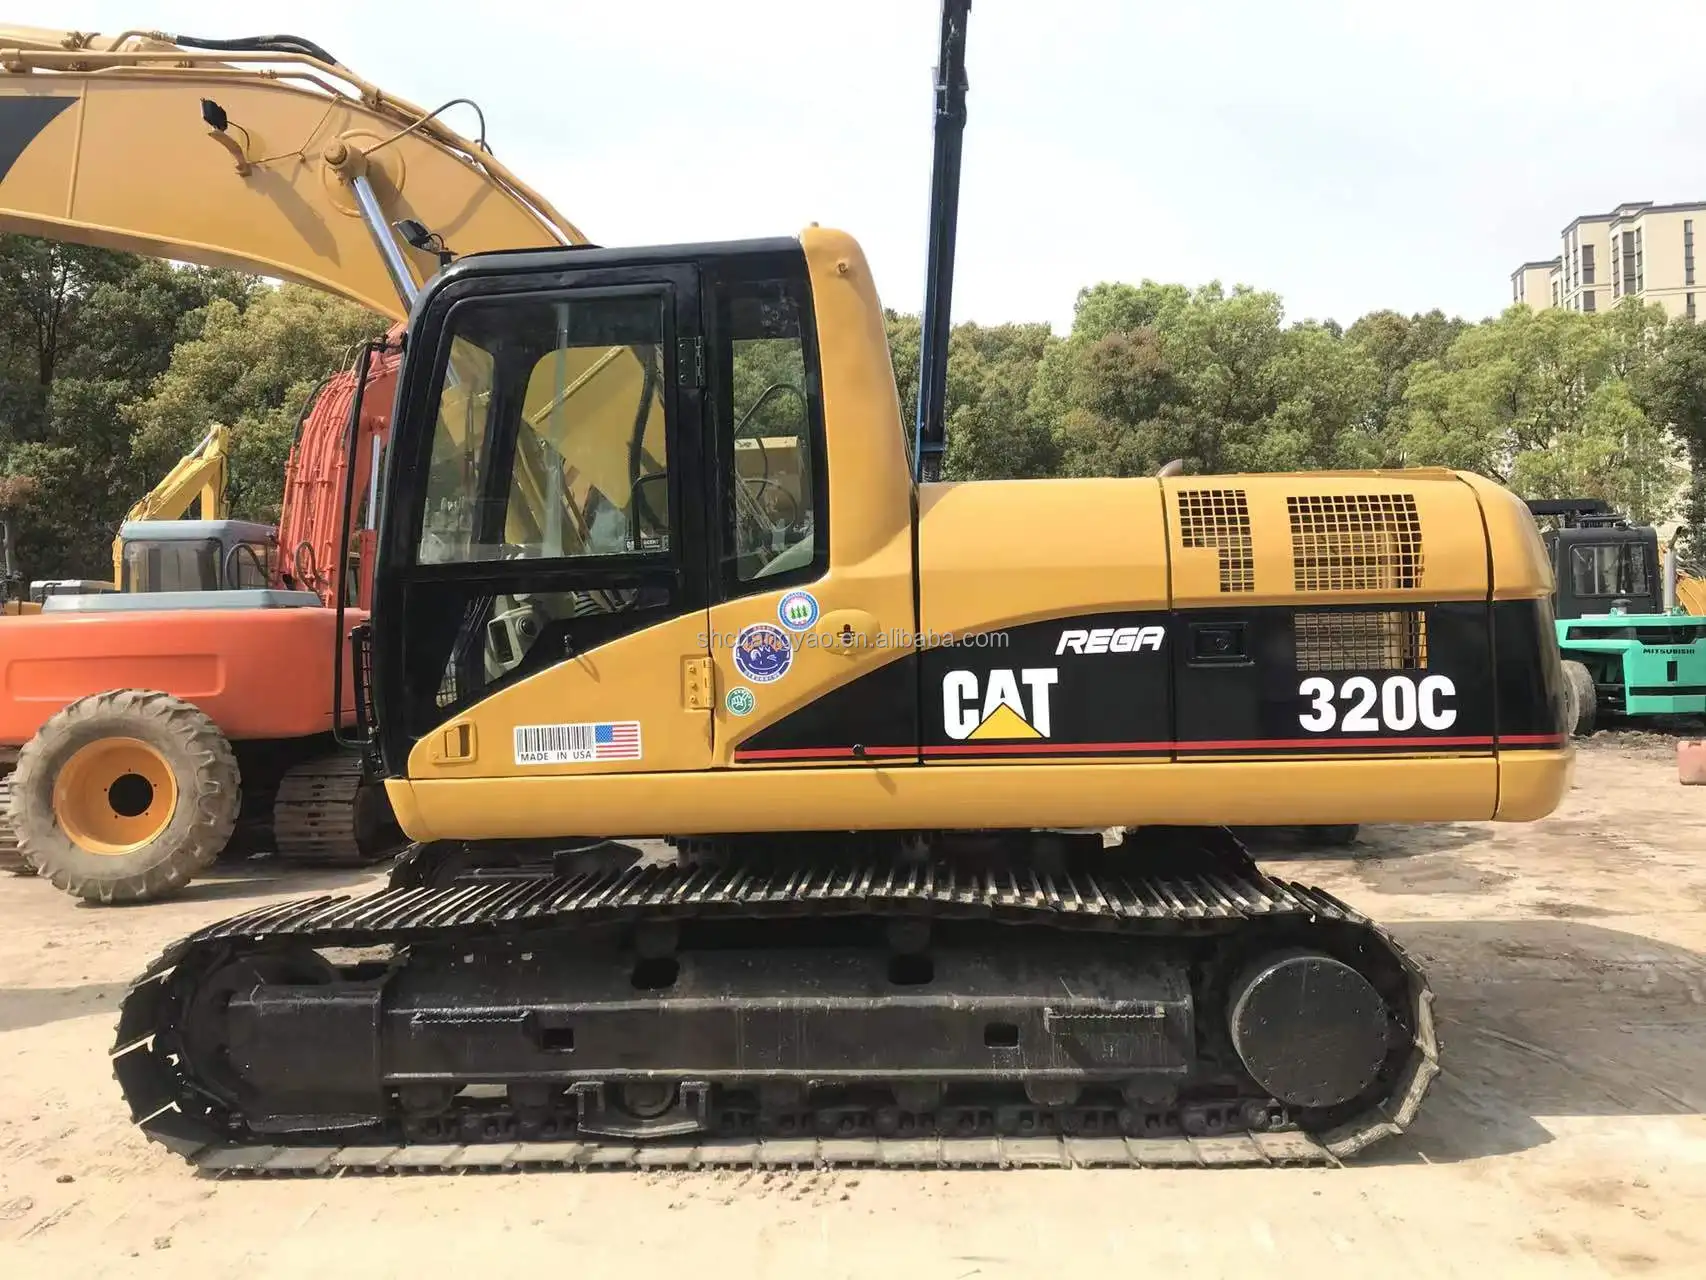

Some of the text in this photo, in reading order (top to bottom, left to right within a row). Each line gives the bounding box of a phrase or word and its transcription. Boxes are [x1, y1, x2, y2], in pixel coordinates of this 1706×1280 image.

[1057, 626, 1165, 655] REGA
[943, 668, 1058, 740] CAT
[1299, 675, 1457, 732] 320C
[521, 750, 592, 762] MADE IN USA
